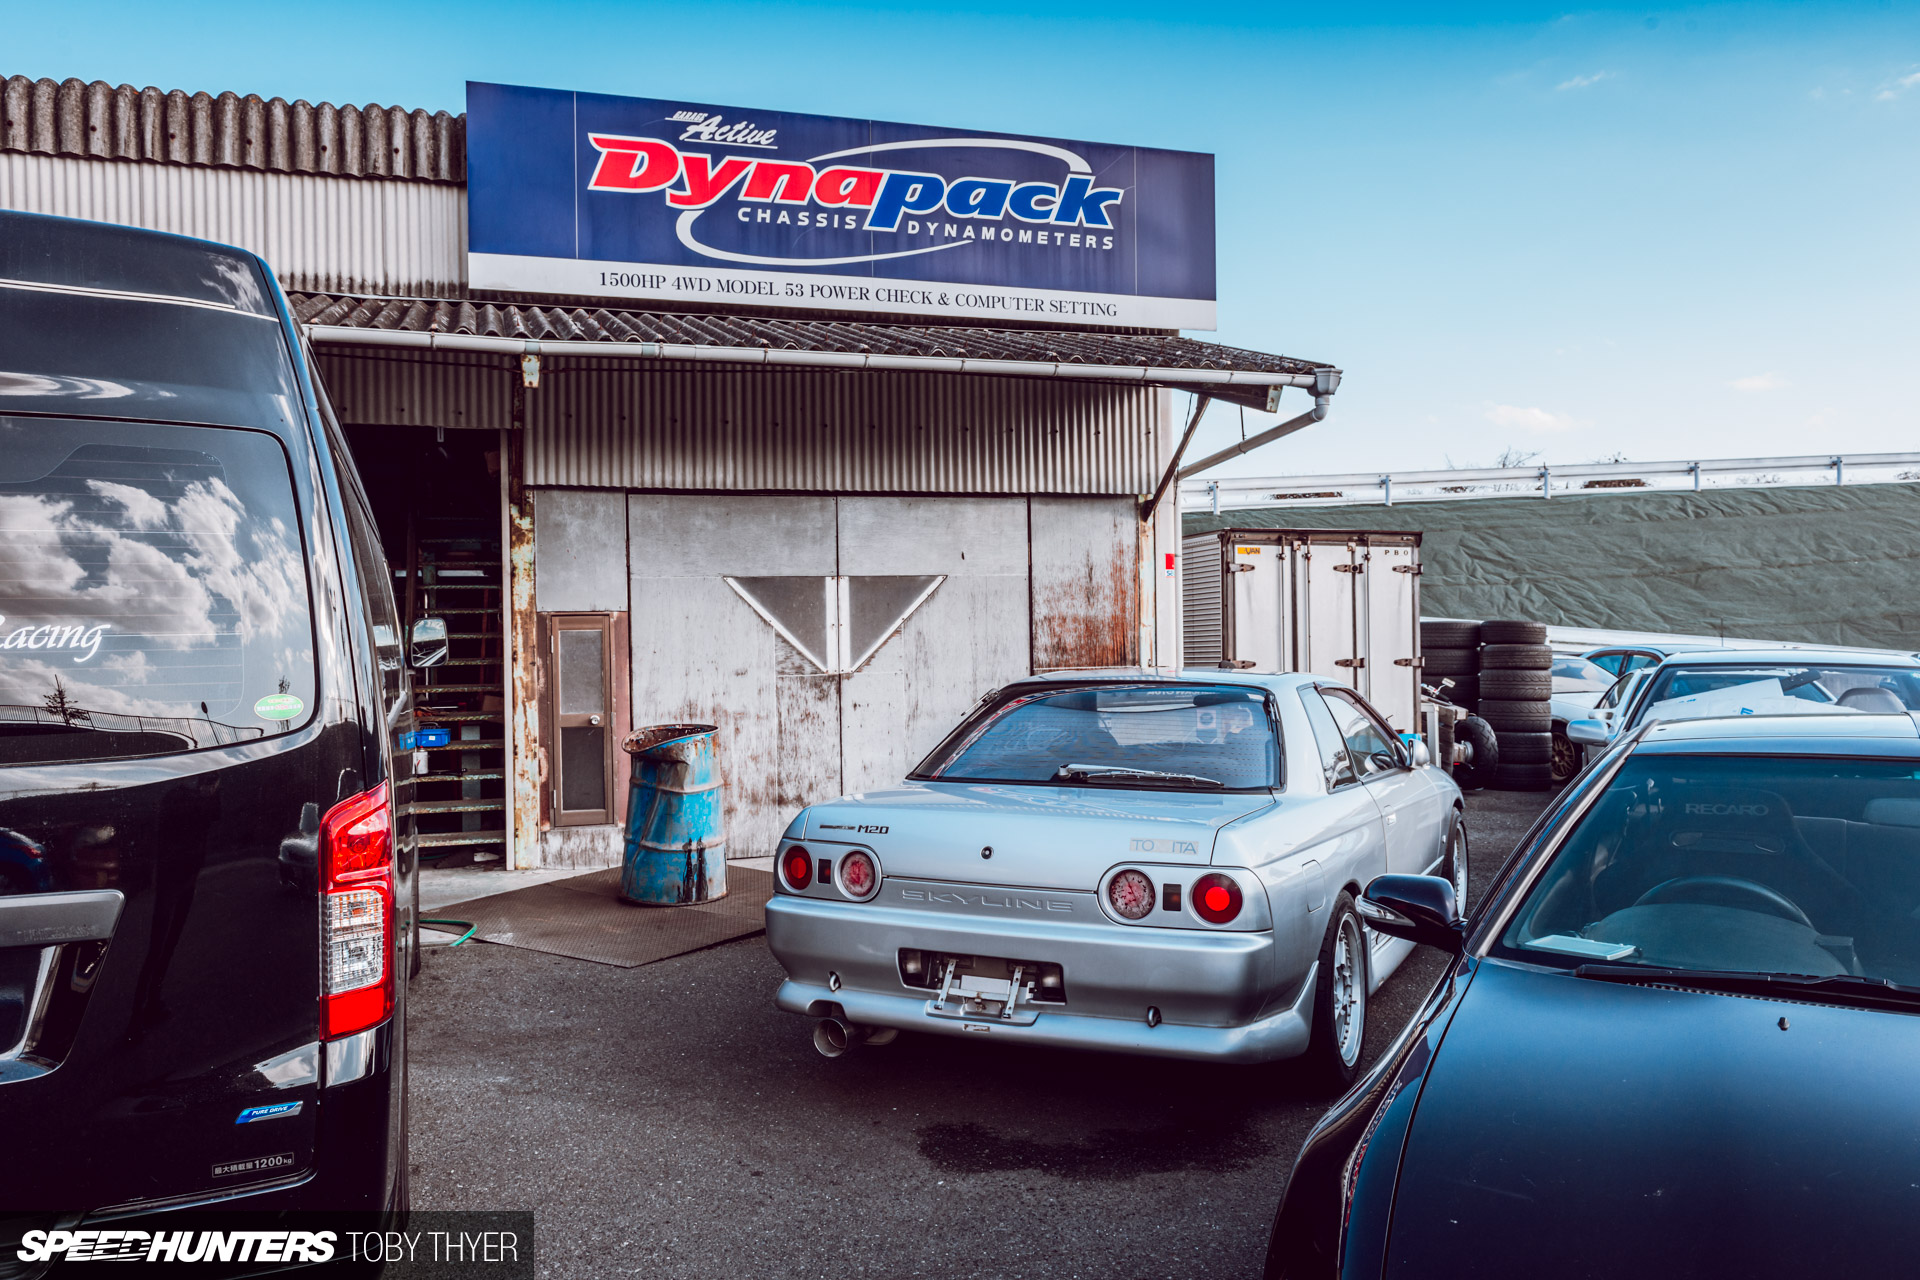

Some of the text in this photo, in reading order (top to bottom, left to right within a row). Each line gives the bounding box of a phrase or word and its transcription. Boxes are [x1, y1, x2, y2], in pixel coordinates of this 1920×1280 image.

[679, 114, 777, 146] Active
[587, 132, 1124, 233] Dynapack
[737, 207, 1114, 250] CHASSIS DYNAMOMETERS
[599, 271, 1118, 317] 1500HP 4WD MODEL 53 POWER CHECK & COMPUTER SETTING
[0, 614, 112, 663] acing
[1685, 803, 1769, 816] RECARO
[857, 824, 890, 835] M20
[902, 888, 1074, 913] SKYLINE
